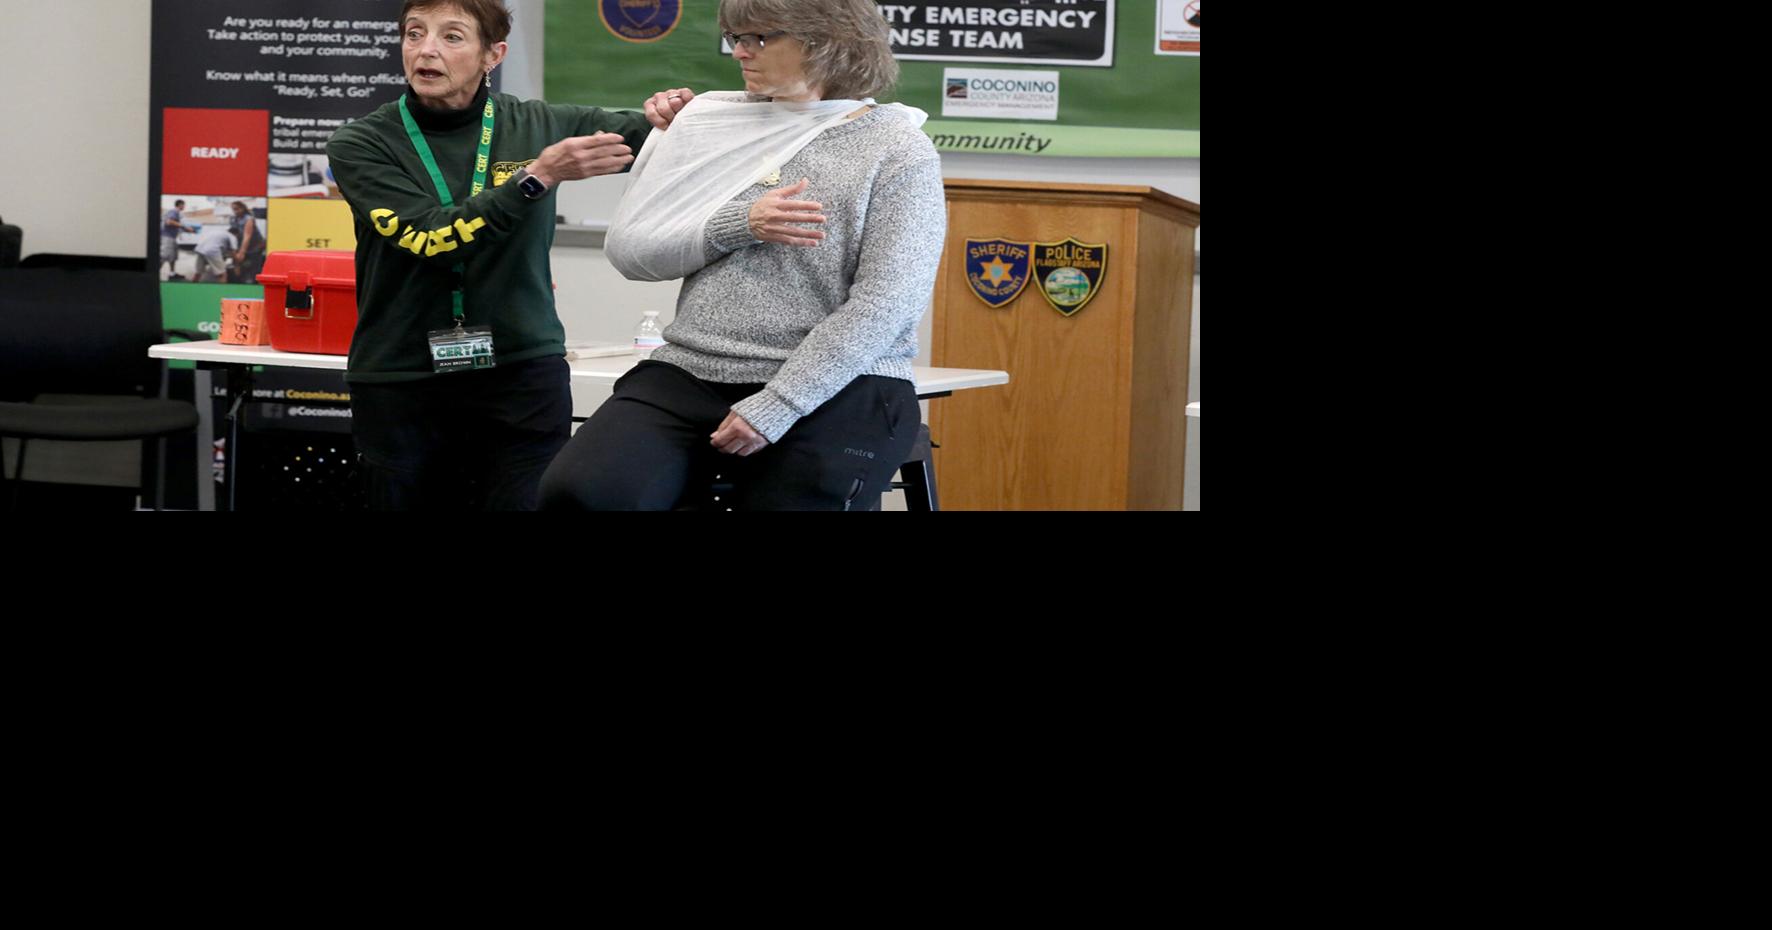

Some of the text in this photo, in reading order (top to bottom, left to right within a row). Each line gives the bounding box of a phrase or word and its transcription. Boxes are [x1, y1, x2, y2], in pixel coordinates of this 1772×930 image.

[223, 16, 399, 32] Are you ready for an emerge
[925, 6, 1097, 28] EMERGENCY
[207, 28, 237, 40] Take
[239, 30, 279, 40] action
[280, 31, 295, 41] to
[296, 32, 342, 43] protect
[888, 28, 1024, 49] NSE TEAM
[259, 44, 391, 60] and your community.
[206, 70, 407, 85] Know what it means when officia
[970, 79, 1056, 93] COCONINO
[273, 116, 316, 127] Prepare
[272, 128, 335, 138] tribal emerg
[481, 126, 492, 145] CERT
[272, 138, 299, 148] Build
[929, 132, 1052, 153] mmunity
[190, 147, 240, 158] READY
[476, 153, 488, 173] CERT
[471, 181, 483, 198] ERT
[369, 208, 486, 256] CERT
[305, 238, 331, 248] SET
[970, 244, 1027, 260] SHERIFF
[1045, 244, 1093, 261] POLICE
[436, 345, 472, 357] CERT
[274, 390, 285, 399] at
[844, 447, 875, 459] mitre
